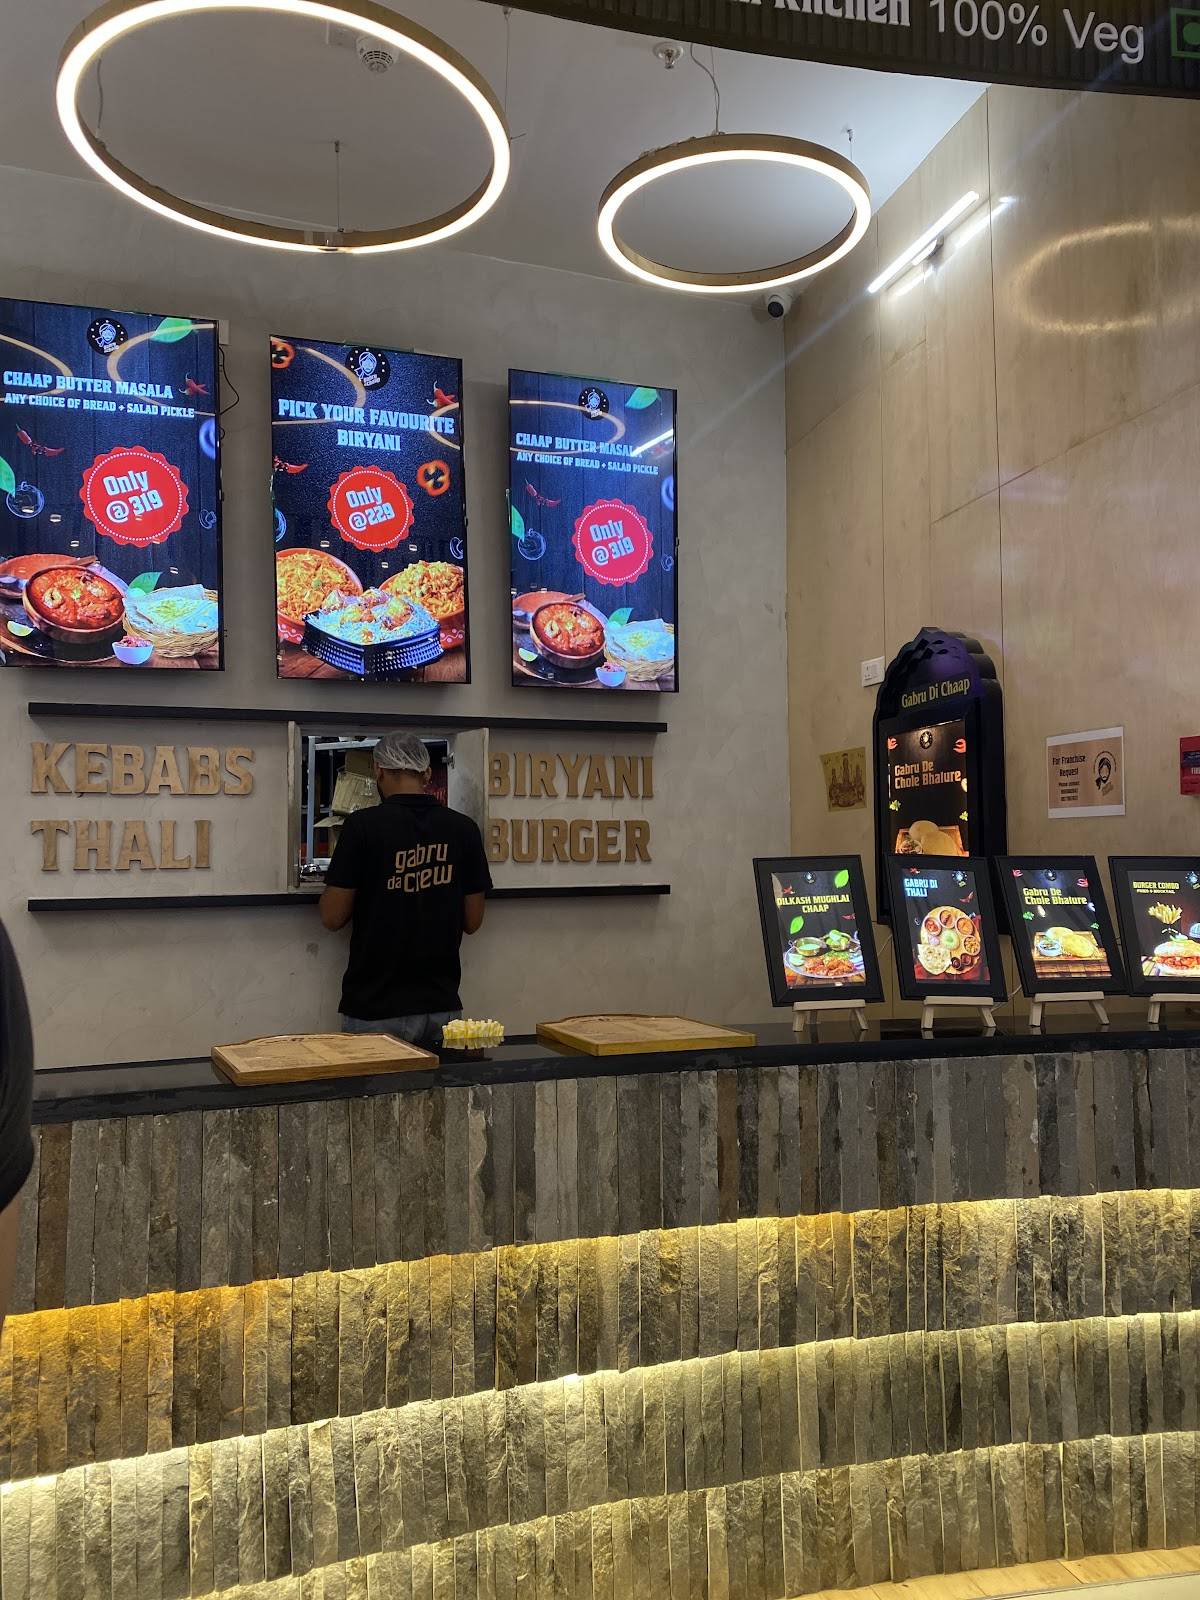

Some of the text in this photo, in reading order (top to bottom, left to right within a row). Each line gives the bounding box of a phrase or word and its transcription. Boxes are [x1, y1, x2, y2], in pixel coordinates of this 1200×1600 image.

[929, 0, 1048, 46] 100%
[1063, 8, 1145, 64] Veg
[3, 371, 174, 399] CHAAP BUTTER MASALA
[4, 392, 27, 404] ANY
[28, 394, 66, 408] CHOICE
[67, 399, 81, 409] OF
[83, 400, 116, 412] BREAD
[127, 403, 158, 415] SALAD
[160, 406, 195, 418] PICKLE
[278, 399, 455, 434] PICK YOUR FAVOURITE
[337, 429, 401, 451] BIRYANI
[515, 432, 552, 448] CHAAP
[555, 437, 596, 453] BUTTER
[516, 452, 533, 462] ANY
[535, 453, 562, 465] CHOICE
[563, 457, 573, 466] OF
[575, 458, 600, 469] BREAD
[608, 461, 631, 472] SALAD
[632, 463, 659, 475] PICKLE
[103, 470, 149, 496] Only
[346, 486, 382, 509] Only
[590, 519, 625, 542] Only
[901, 679, 970, 708] Gabru Di Chaap
[30, 742, 256, 795] KEBABS
[488, 752, 654, 799] BIRYANI
[895, 760, 934, 777] Gabru De
[895, 770, 962, 790] Chole Bhature
[30, 820, 211, 872] THALI
[488, 818, 652, 864] BURGER
[395, 843, 449, 873] gabru
[387, 864, 454, 893] da crew
[904, 878, 938, 889] GABRU DI
[777, 894, 850, 906] DILKASH MUGHLAI
[905, 887, 928, 898] THALI
[1023, 887, 1062, 897] Gabru De
[1025, 896, 1087, 905] Chole Bhature
[802, 904, 829, 913] CHAAP
